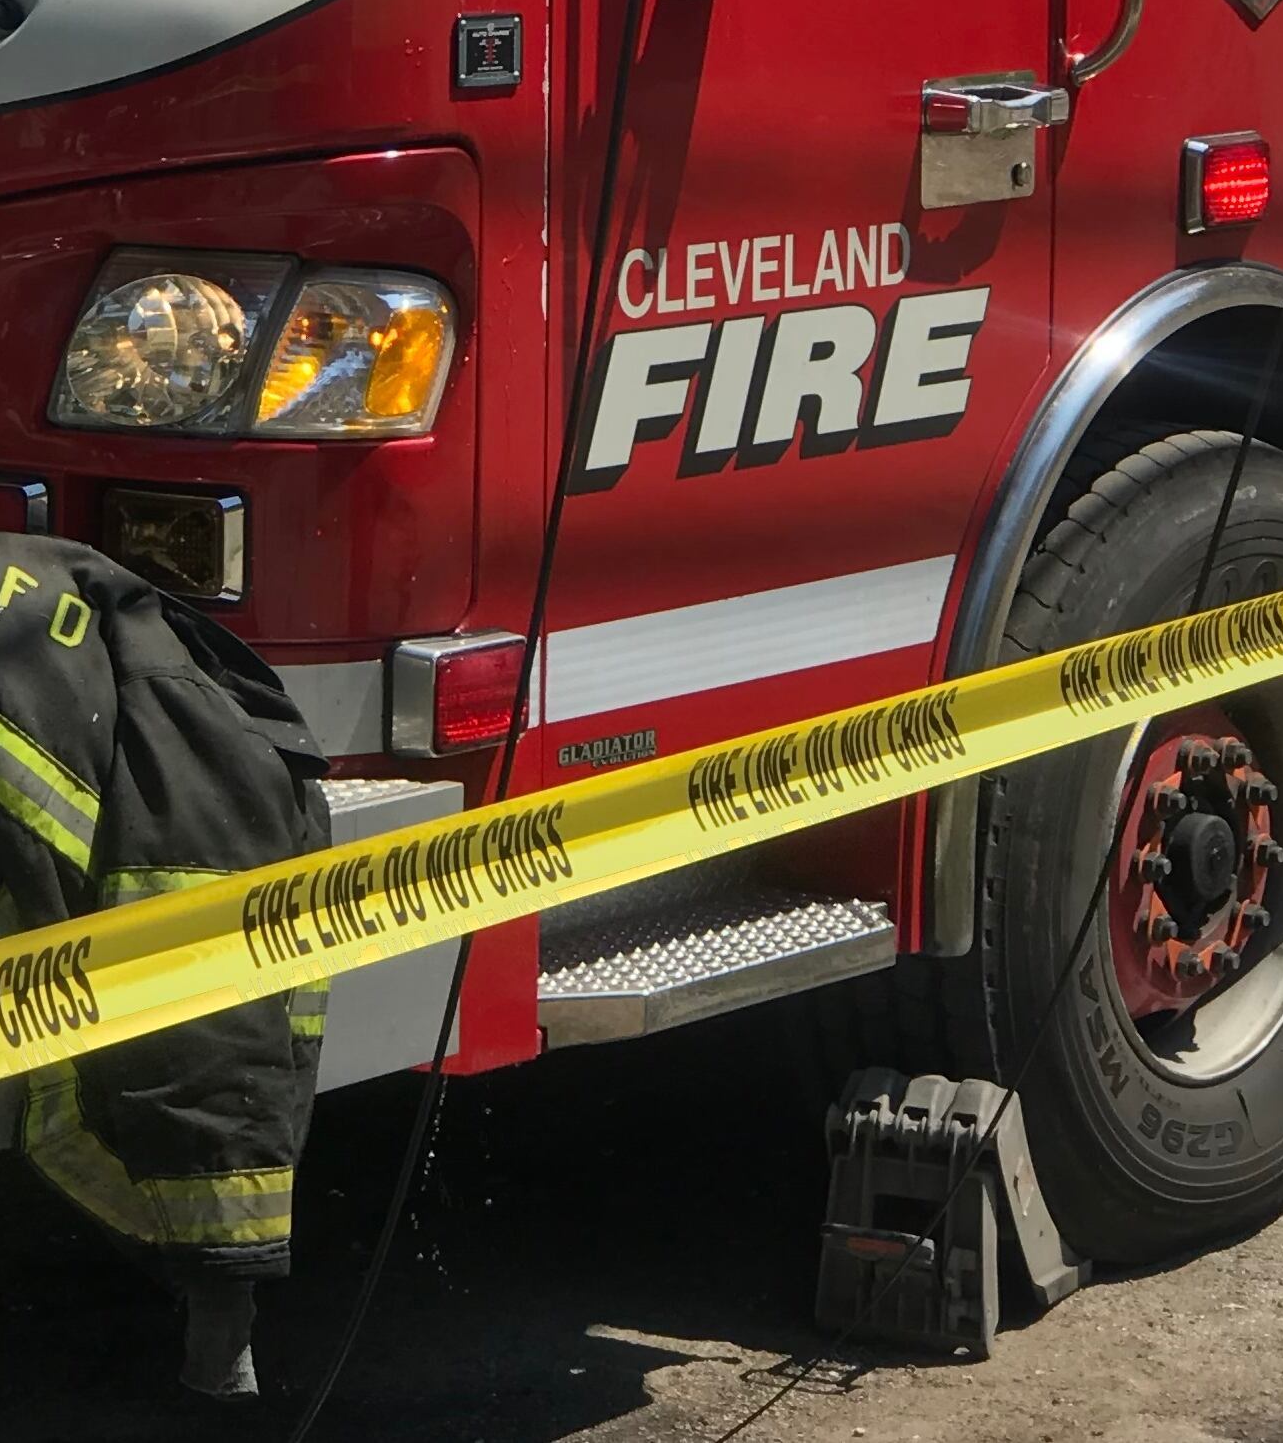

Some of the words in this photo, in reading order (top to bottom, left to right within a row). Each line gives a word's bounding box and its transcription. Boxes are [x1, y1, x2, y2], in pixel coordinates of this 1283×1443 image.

[618, 221, 912, 320] CLEVELAND
[578, 287, 992, 482] FIRE
[1060, 642, 1114, 717] FIRE
[1157, 619, 1195, 689] DO
[1187, 608, 1234, 679] NOT
[558, 730, 656, 767] GLADIATOR
[688, 747, 751, 832] FIRE
[804, 719, 846, 798] DO
[839, 706, 893, 787] NOT
[886, 686, 967, 773] CROSS
[242, 871, 314, 969] FIRE
[382, 839, 428, 928] DO
[424, 822, 485, 915] NOT
[481, 798, 574, 898] CROSS
